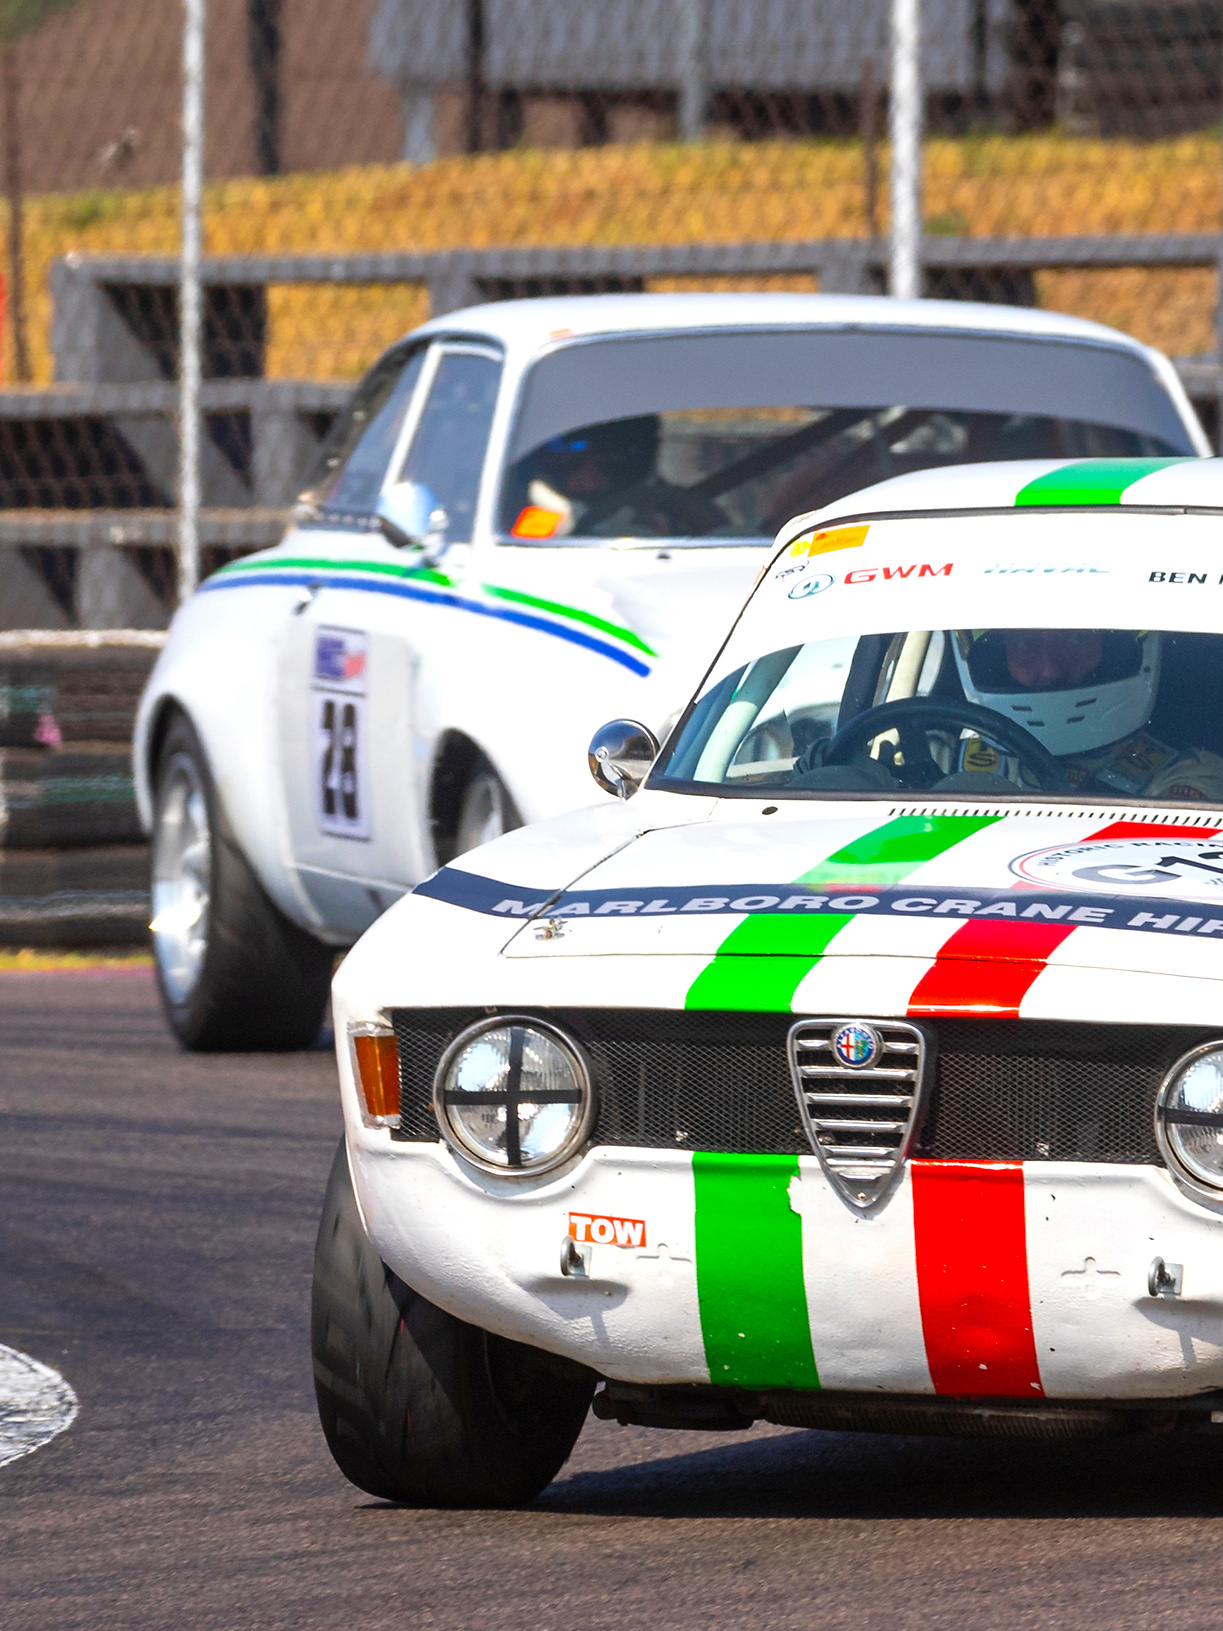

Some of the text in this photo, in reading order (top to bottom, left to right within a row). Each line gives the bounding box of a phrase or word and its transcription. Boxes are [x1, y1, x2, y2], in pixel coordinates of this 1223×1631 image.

[844, 562, 955, 585] GWM
[1148, 571, 1208, 585] BEN
[491, 895, 881, 917] MARLBORO
[890, 897, 1114, 924] CRANE
[570, 1215, 644, 1245] TOW
